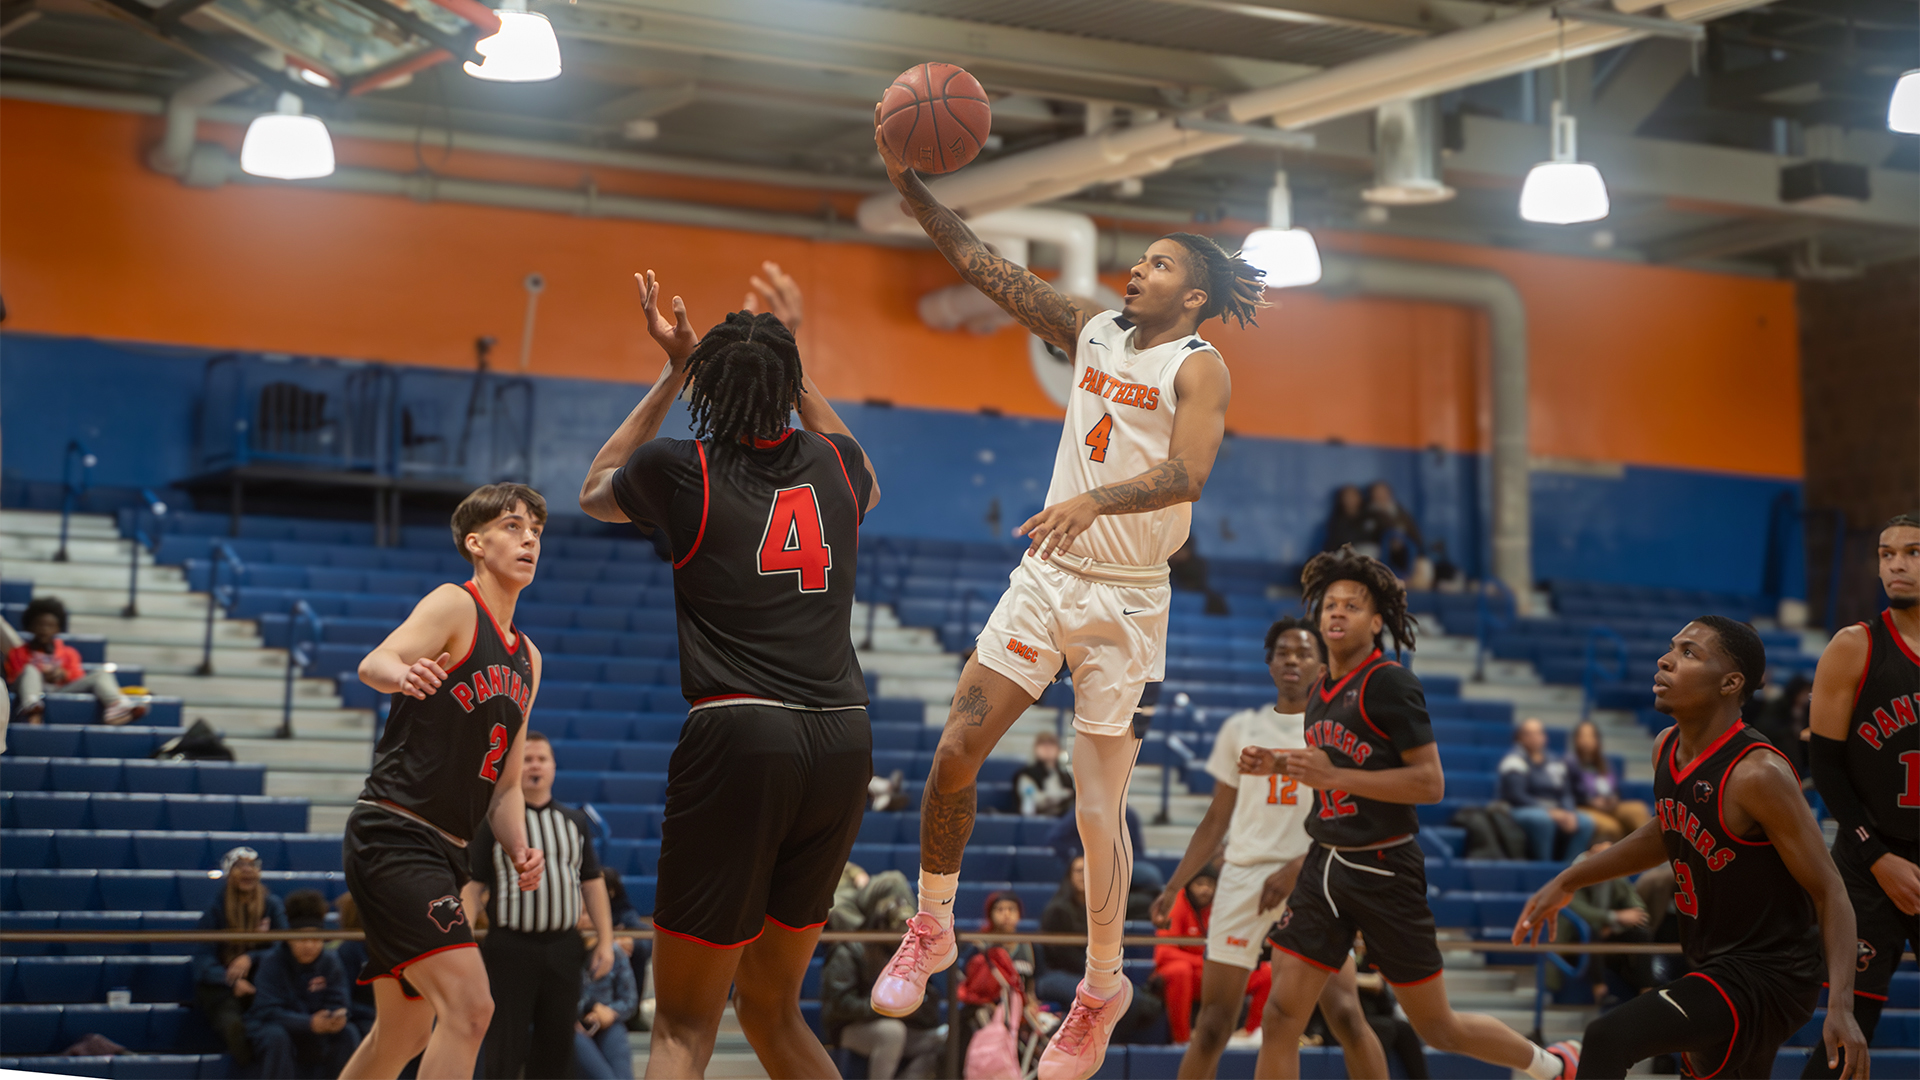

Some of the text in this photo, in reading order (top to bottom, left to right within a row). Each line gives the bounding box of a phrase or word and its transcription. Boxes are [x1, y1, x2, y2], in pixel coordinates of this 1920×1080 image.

[1078, 366, 1160, 411] PANTHERS
[1085, 412, 1113, 464] 4
[757, 483, 832, 593] 4
[1006, 637, 1039, 663] BMCC
[450, 664, 530, 722] PANTHE
[479, 722, 508, 784] 2
[1266, 773, 1298, 806] 12
[1672, 858, 1698, 919] 3
